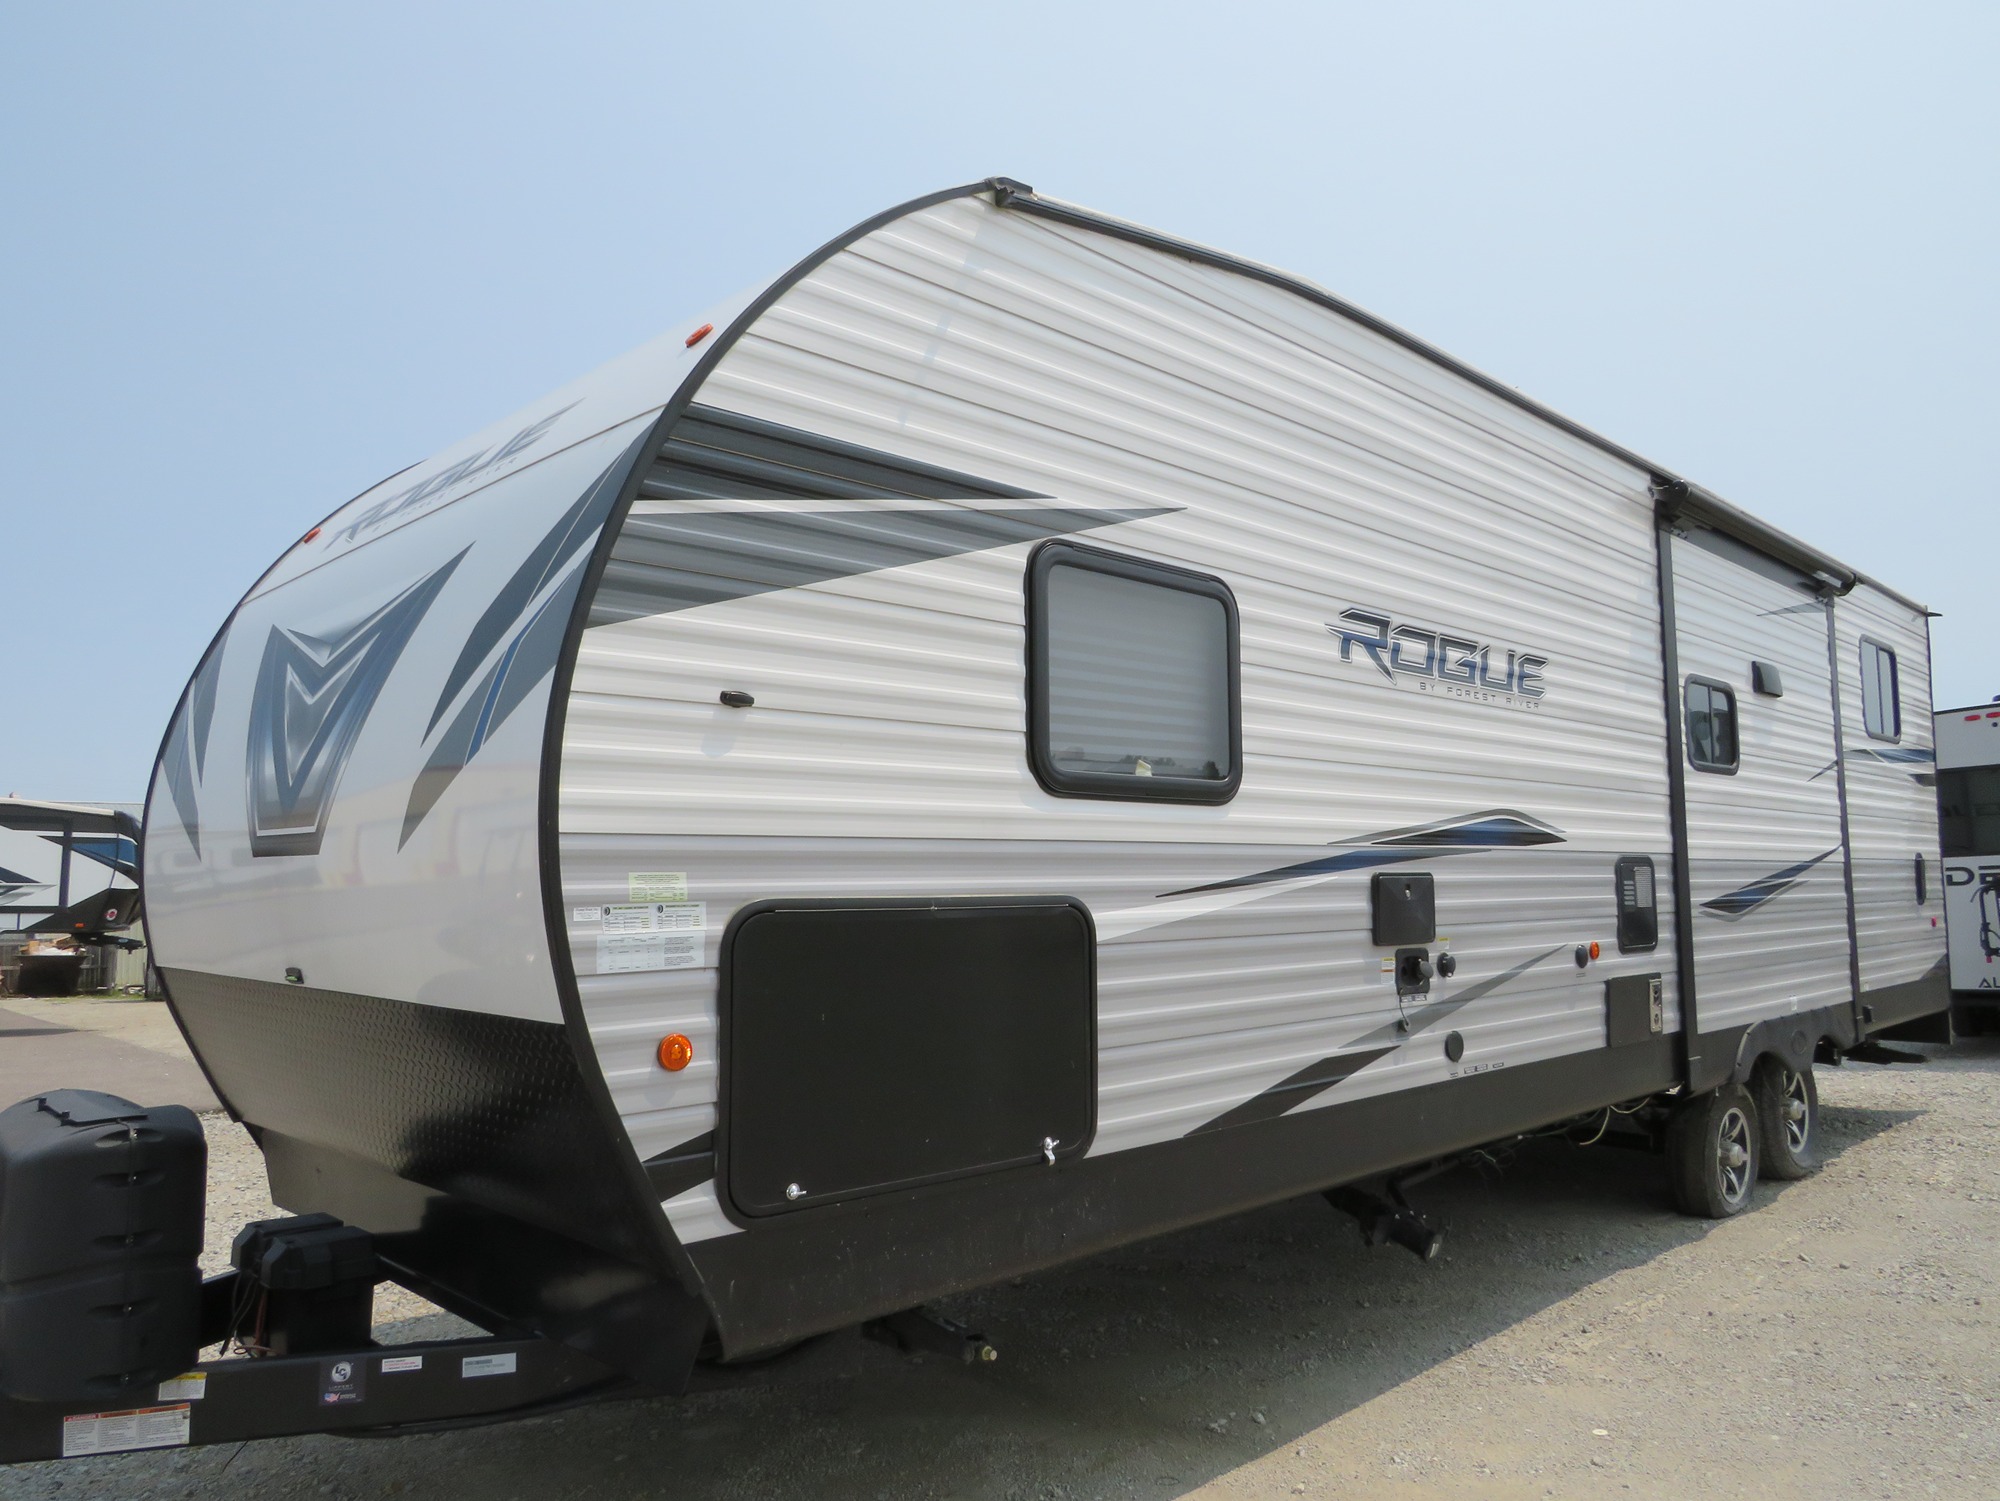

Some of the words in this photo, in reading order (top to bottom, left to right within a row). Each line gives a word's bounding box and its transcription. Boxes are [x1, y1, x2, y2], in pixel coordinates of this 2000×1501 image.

[1324, 608, 1548, 699] ROGUE
[1419, 682, 1435, 692] BY
[1447, 687, 1497, 702] FOREST
[1505, 697, 1540, 709] RIVER
